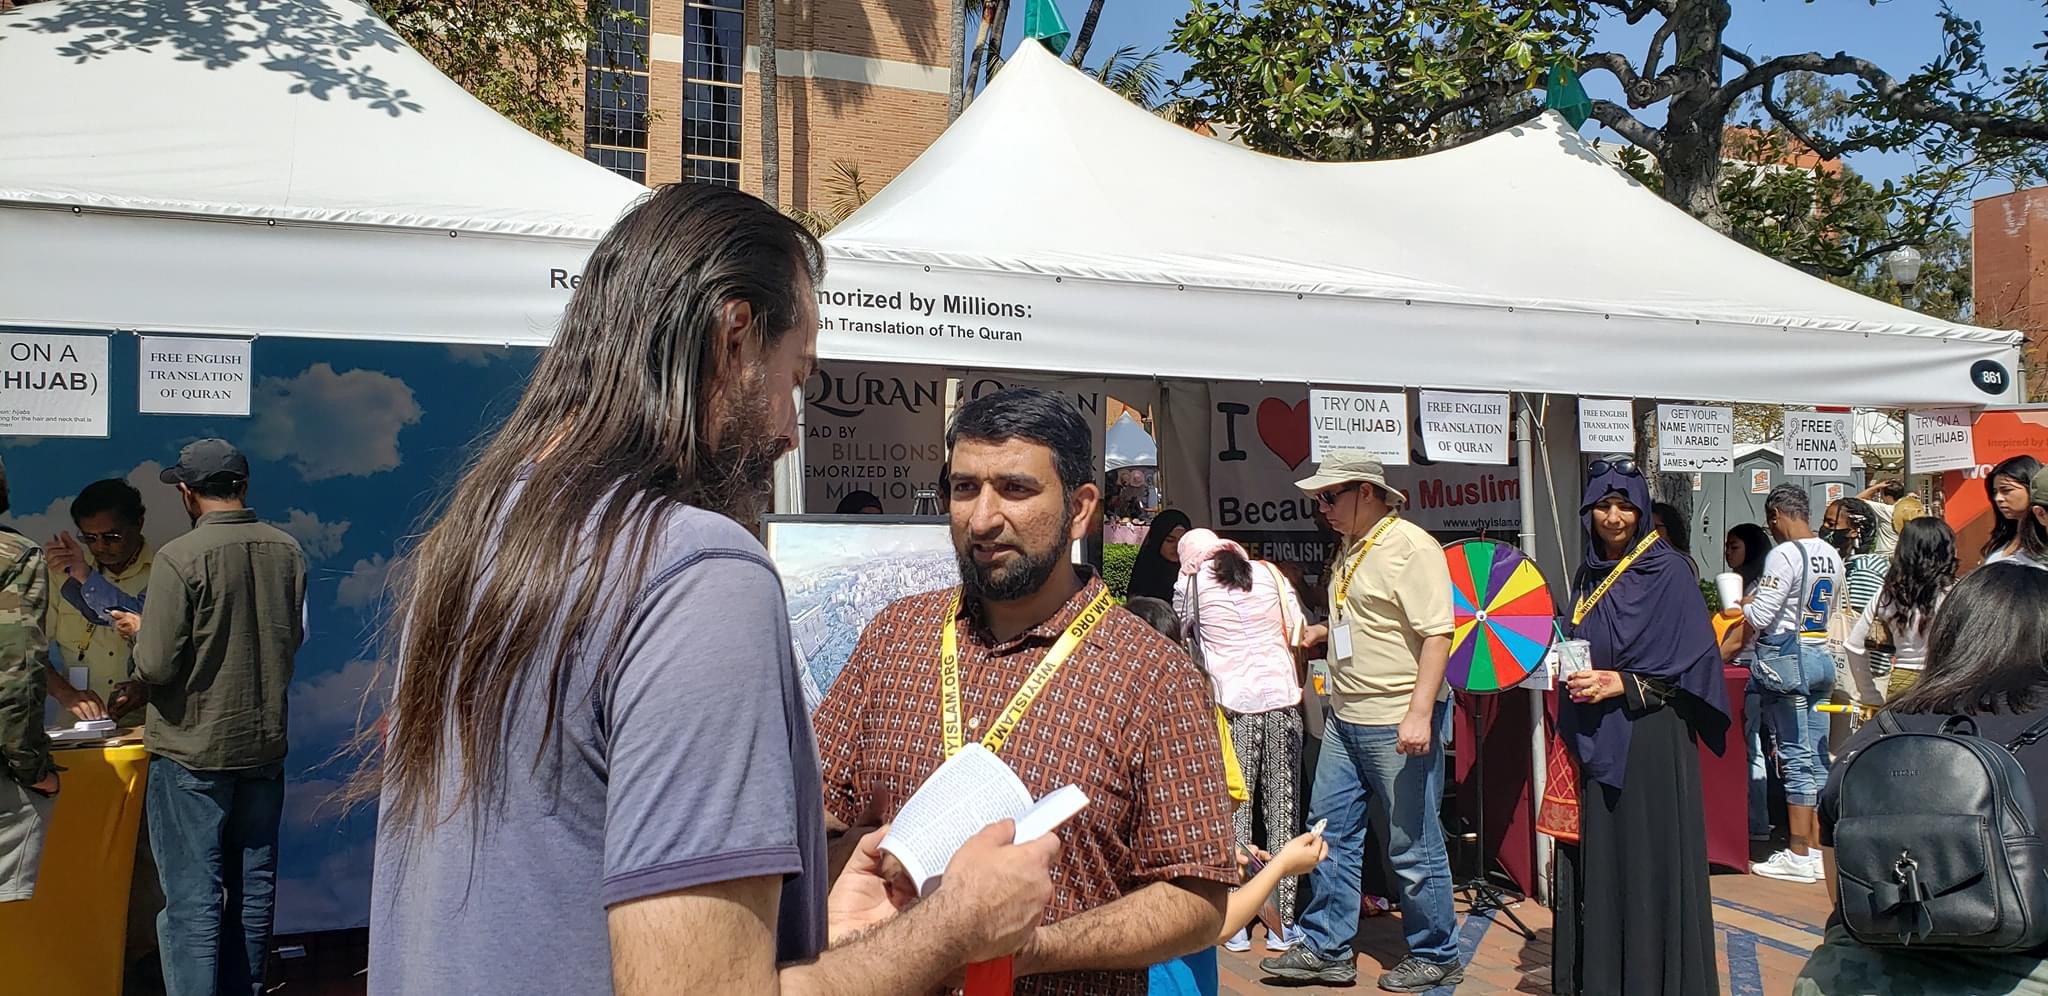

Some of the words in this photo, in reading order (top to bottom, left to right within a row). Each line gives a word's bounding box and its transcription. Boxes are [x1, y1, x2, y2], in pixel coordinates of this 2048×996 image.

[551, 268, 583, 289] Re
[817, 289, 901, 310] morized
[910, 292, 936, 316] by
[943, 294, 1031, 318] Millions:
[839, 318, 924, 336] Translation
[929, 324, 944, 337] of
[947, 324, 975, 338] The
[979, 327, 1022, 341] Quran
[11, 343, 51, 361] ON
[60, 344, 78, 362] A
[151, 352, 182, 363] FREE
[186, 353, 241, 364] ENGLISH
[148, 370, 243, 381] TRANSLATION
[1983, 370, 2001, 384] 861
[2, 371, 97, 396] HIJAB)
[160, 388, 178, 398] OF
[182, 389, 231, 400] QURAN
[805, 370, 938, 417] QURAN
[1320, 396, 1350, 411] TRY
[1354, 398, 1375, 412] ON
[1378, 399, 1390, 412] A
[1427, 401, 1453, 413] FREE
[1455, 403, 1501, 415] ENGLISH
[1584, 409, 1599, 417] FREE
[1600, 410, 1628, 418] ENGLISH
[1671, 409, 1689, 419] GET
[1691, 410, 1717, 420] YOUR
[1314, 416, 1402, 436] VEIL(HIJAB)
[1426, 421, 1502, 434] TRANSLATION
[1584, 421, 1630, 430] TRANSLATION
[1660, 421, 1686, 432] NAME
[1689, 423, 1730, 433] WRITTEN
[1801, 419, 1832, 432] FREE
[1915, 416, 1934, 429] TRY
[1936, 415, 1950, 427] ON
[1952, 414, 1960, 425] A
[808, 426, 832, 438] AD
[840, 426, 857, 438] BY
[1217, 402, 1249, 461] I
[1599, 434, 1624, 442] QURAN
[1912, 430, 1968, 447] VEIL(HIJAB)
[1438, 441, 1452, 451] OF
[1454, 442, 1493, 454] QURAN
[1673, 435, 1682, 445] IN
[1685, 435, 1719, 446] ARABIC
[1796, 438, 1837, 452] HENNA
[1988, 437, 2029, 448] Inspired
[832, 443, 939, 461] BILLIONS
[1663, 459, 1687, 467] JAMES
[1793, 457, 1838, 471] TATTOO
[805, 465, 887, 478] EMORIZED
[893, 466, 911, 478] BY
[1419, 474, 1520, 509] Muslim
[1219, 497, 1314, 526] Becau
[1443, 518, 1520, 530] www.whyislam.o
[1263, 541, 1324, 562] ENGLISH
[1811, 557, 1835, 573] SZA
[1072, 592, 1110, 637] LAM.ORG
[944, 654, 959, 756] YISLAM.ORG
[984, 662, 1056, 753] WHYISLAM.O
